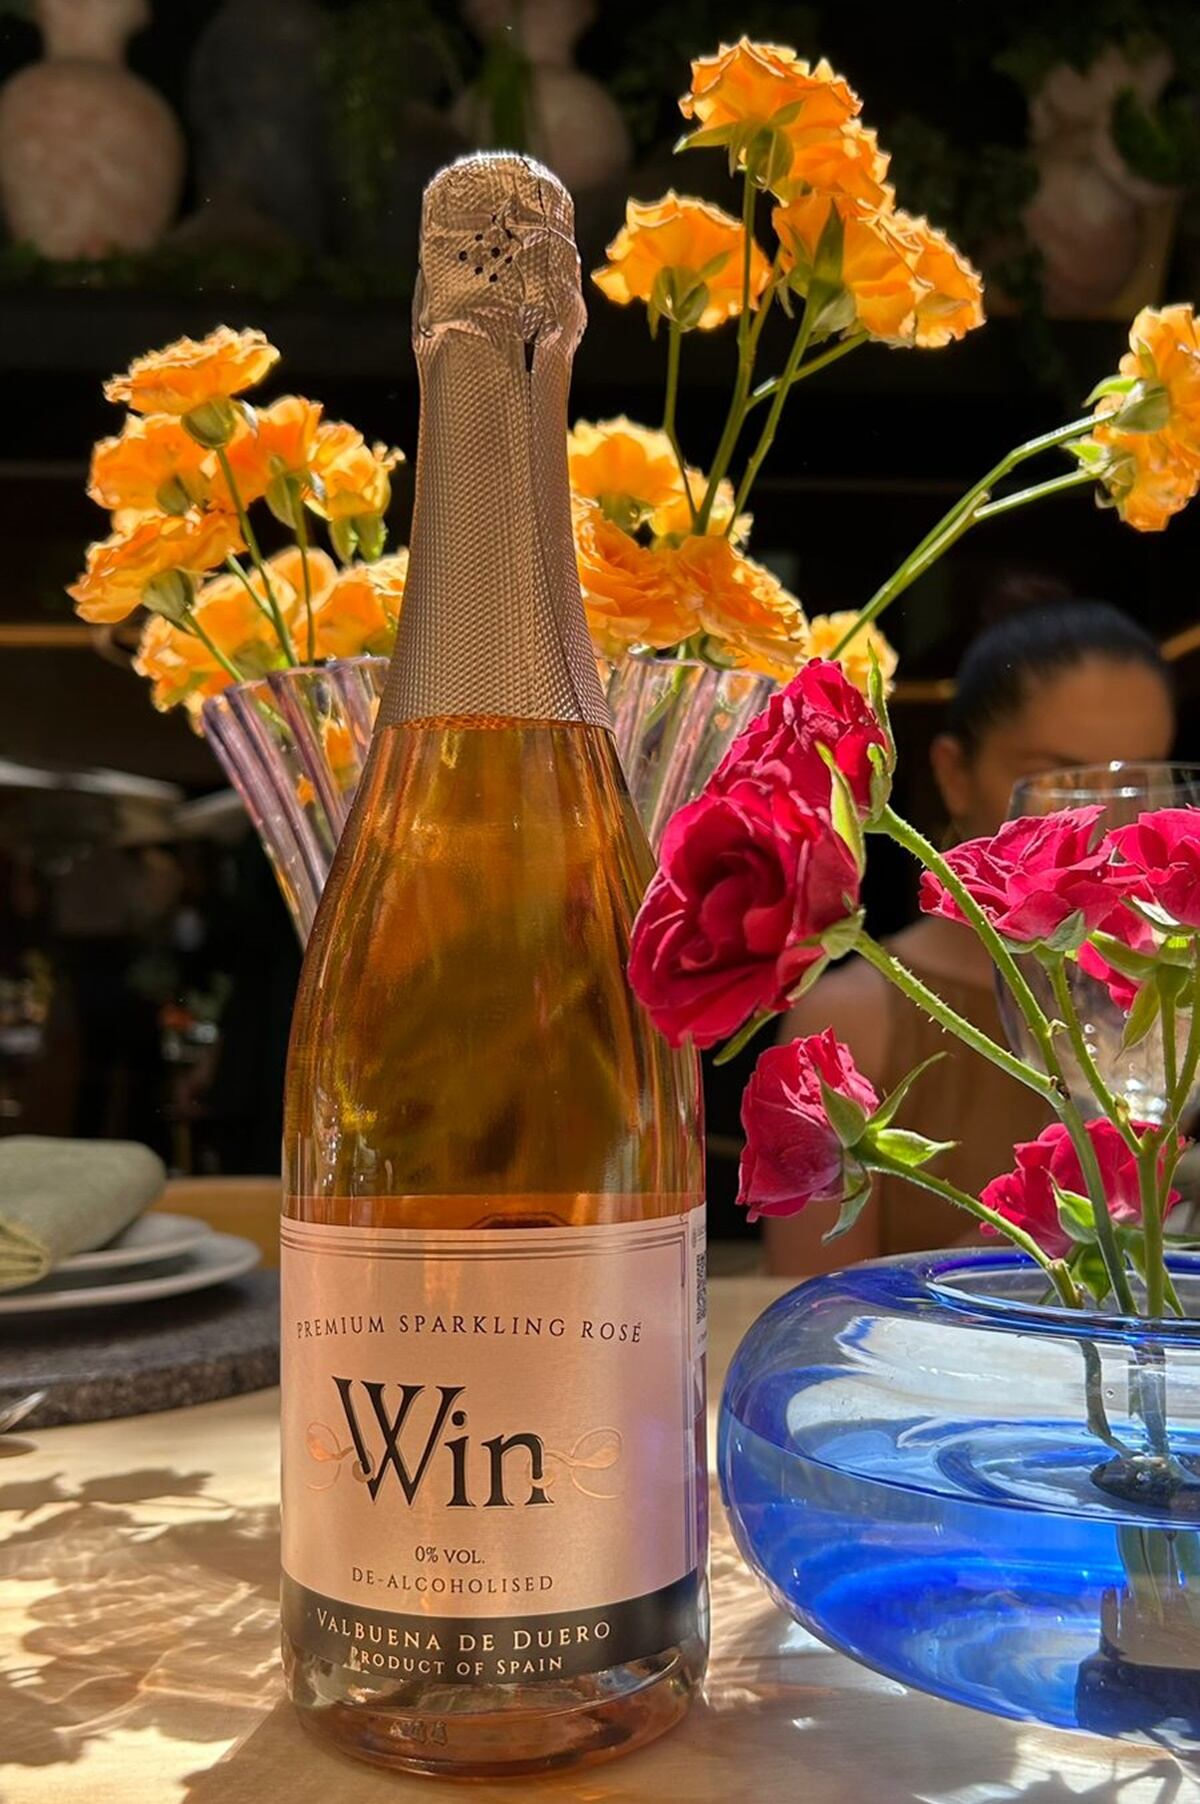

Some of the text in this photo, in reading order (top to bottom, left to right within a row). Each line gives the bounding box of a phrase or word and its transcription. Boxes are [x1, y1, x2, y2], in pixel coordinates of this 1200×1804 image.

[297, 1315, 642, 1343] PREMIUM SPARKLING ROSÉ
[332, 1376, 555, 1507] Win
[415, 1546, 485, 1564] 0% VOL.
[352, 1567, 553, 1593] DE-ALCOHOLISED
[316, 1608, 611, 1652] VALBUENA DE DUERO
[350, 1646, 563, 1676] PRODUCT OF SPAIN
